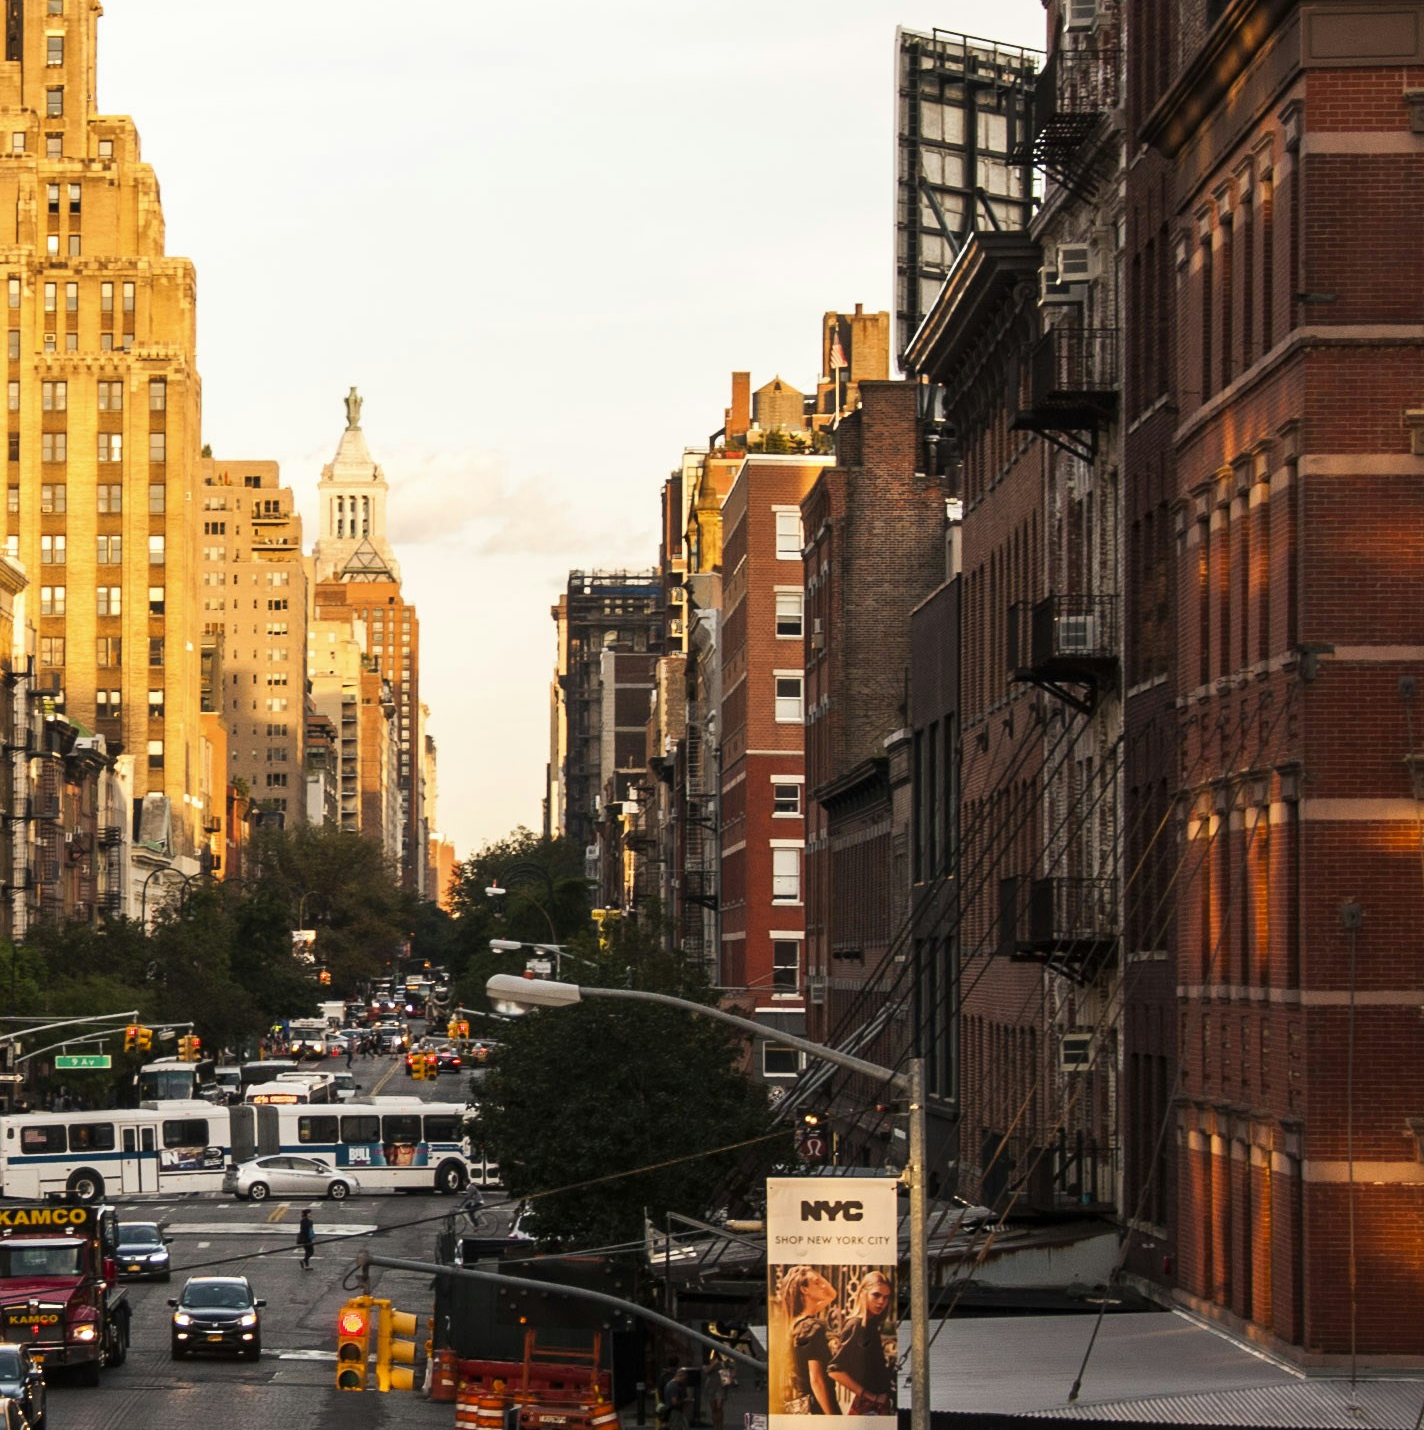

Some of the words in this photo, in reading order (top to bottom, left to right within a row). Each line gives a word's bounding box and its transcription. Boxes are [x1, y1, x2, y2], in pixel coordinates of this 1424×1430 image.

[70, 1058, 78, 1066] 9
[800, 1200, 864, 1221] NYC
[775, 1235, 804, 1245] SHOP
[807, 1235, 832, 1245] NEW
[836, 1236, 864, 1246] YORK
[867, 1236, 891, 1246] CITY
[9, 1314, 59, 1325] KAMCO
